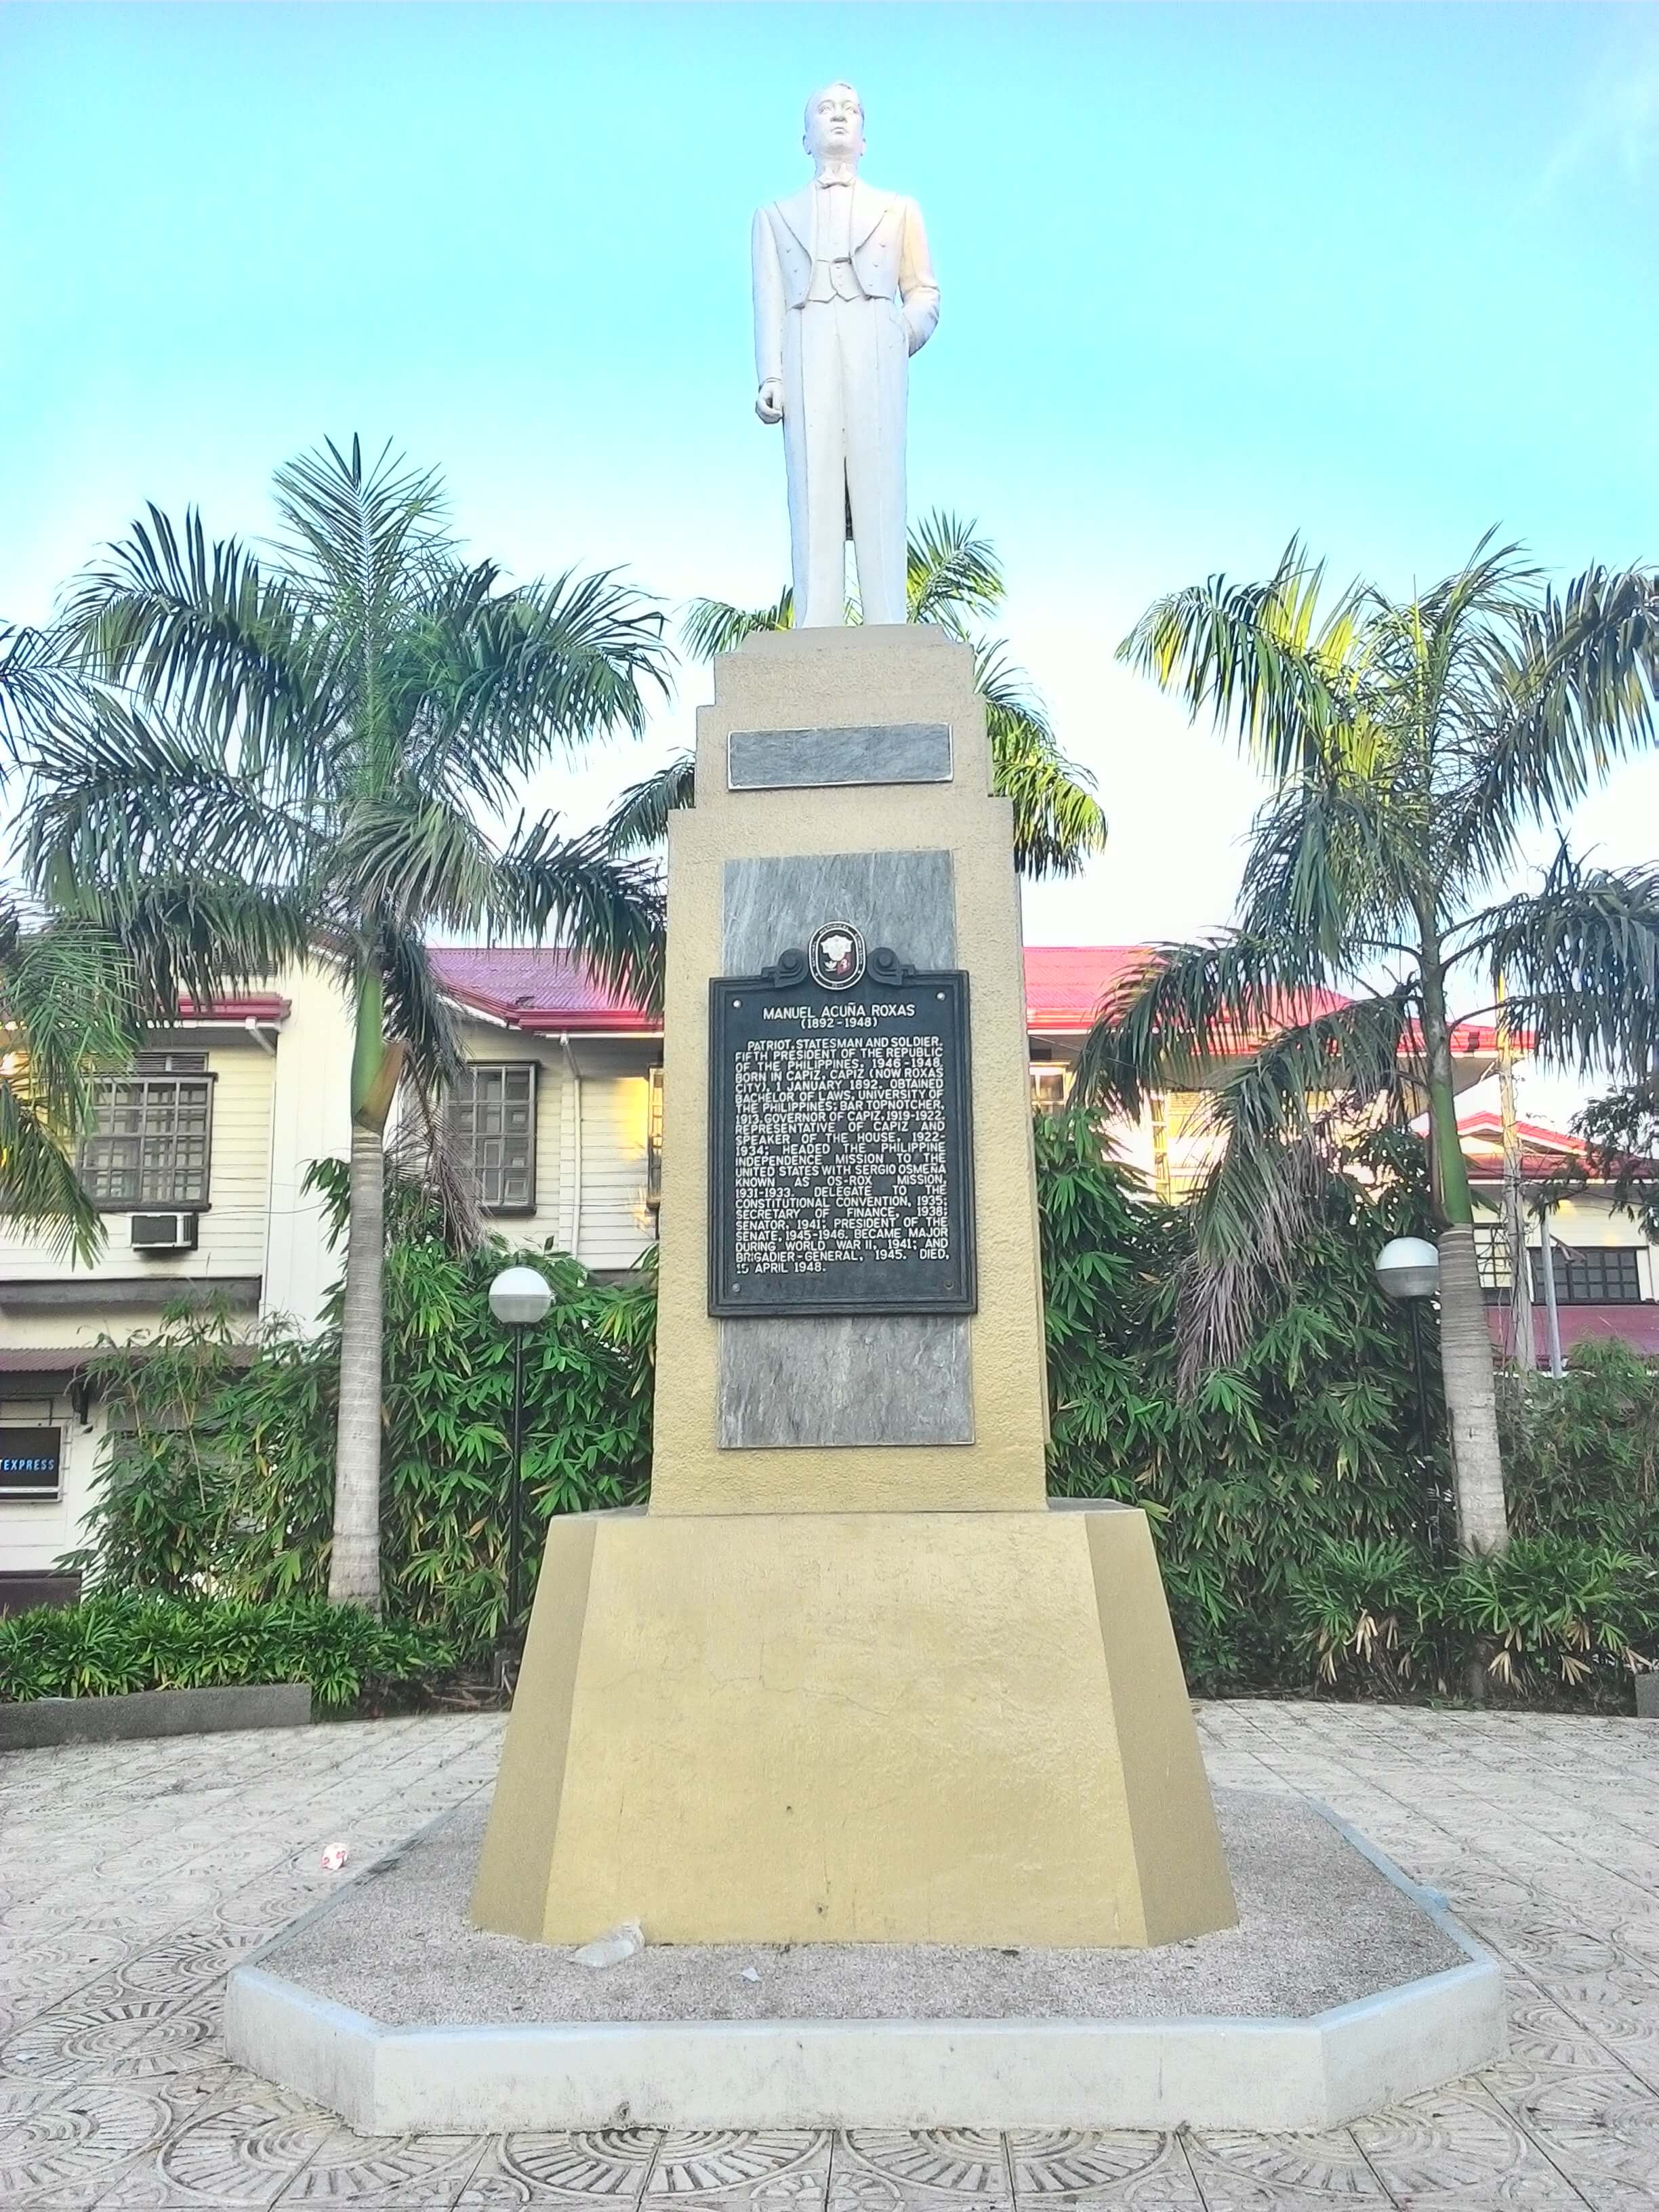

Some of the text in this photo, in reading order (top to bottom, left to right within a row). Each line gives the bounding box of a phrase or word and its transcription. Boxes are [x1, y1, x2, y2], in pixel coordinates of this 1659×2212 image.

[763, 1002, 915, 1019] MANUEL ACUÑA ROXAS
[796, 1038, 862, 1050] STATESMAN
[865, 1038, 888, 1048] AND
[891, 1036, 943, 1048] SOLDIER.
[735, 1048, 943, 1062] FIFTH PRESIDENT OF THE REPUBLIC
[735, 1063, 751, 1073] OF
[758, 1062, 781, 1072] THE
[735, 1068, 943, 1083] BORN IN CAPIZ, CAPIZ (NOW ROXAS
[777, 1082, 781, 1092] 1
[787, 1081, 842, 1092] JANUARY
[850, 1080, 882, 1090] 1892.
[890, 1079, 943, 1090] OBTAINED
[735, 1089, 943, 1103] BACHELOR OF LAWS, UNIVERSITY OF
[736, 1100, 945, 1113] THE PHILIPPINES; BAR TOPNOTCHER,
[736, 1111, 945, 1124] 1913. GOVERNOR OF CAPIZ, 1919-1922.
[736, 1121, 945, 1134] REPRESENTATIVE OF CAPIZ AND
[735, 1132, 945, 1145] SPEAKER OF THE HOUSE, 1922-
[736, 1142, 946, 1156] 1934; HEADED THE PHILIPPINE
[736, 1153, 946, 1166] INDEPENDENCE MISSION TO THE
[735, 1167, 775, 1177] UNITED
[779, 1166, 819, 1176] STATES
[821, 1166, 851, 1175] WITH
[855, 1165, 896, 1174] SERGIO
[736, 1177, 775, 1187] KNOWN
[794, 1177, 810, 1186] AS
[827, 1176, 872, 1186] OS-ROX
[736, 1185, 947, 1198] 1931-1933. DELEGATE TO THE
[736, 1195, 947, 1208] CONSTITUTIONAL CONVENTION, 1935;
[736, 1206, 947, 1219] SECRETARY OF FINANCE, 1938;
[736, 1217, 948, 1231] SENATOR, 1941; PRESIDENT OF THE
[736, 1231, 782, 1241] SENATE,
[854, 1229, 901, 1239] BECAME
[909, 1227, 948, 1237] MAJOR
[736, 1238, 948, 1252] DURING WORLD WAR II, 1941; AND
[875, 1250, 907, 1260] 1945.
[920, 1249, 949, 1258] DIED,
[754, 1263, 788, 1273] APRIL
[794, 1262, 826, 1272] 1948.
